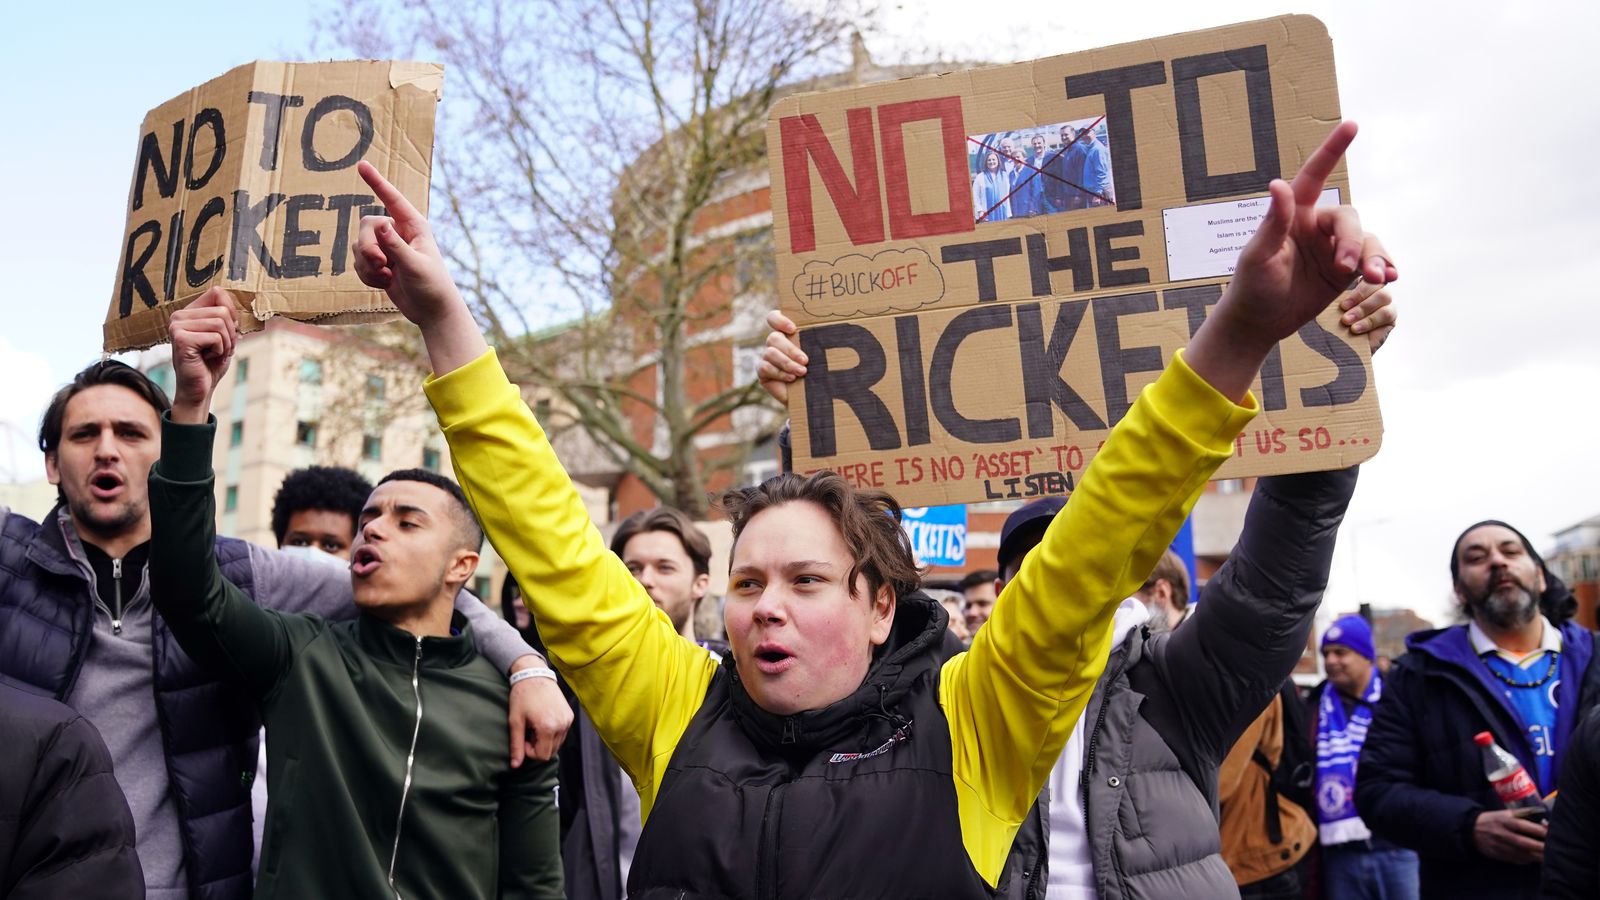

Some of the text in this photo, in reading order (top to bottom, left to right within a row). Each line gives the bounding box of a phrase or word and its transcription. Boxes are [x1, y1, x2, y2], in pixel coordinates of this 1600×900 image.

[132, 90, 375, 212] NO TO
[778, 44, 1281, 254] NO TO
[118, 189, 390, 319] RICKET
[805, 263, 918, 300] #BUCKOFF
[940, 220, 1150, 302] THE
[1209, 246, 1234, 254] Against
[805, 461, 884, 489] ERE
[895, 455, 924, 485] IS
[931, 455, 965, 483] NO
[1051, 444, 1084, 472] TO
[1255, 427, 1287, 454] US
[984, 470, 1076, 499] LISTEN
